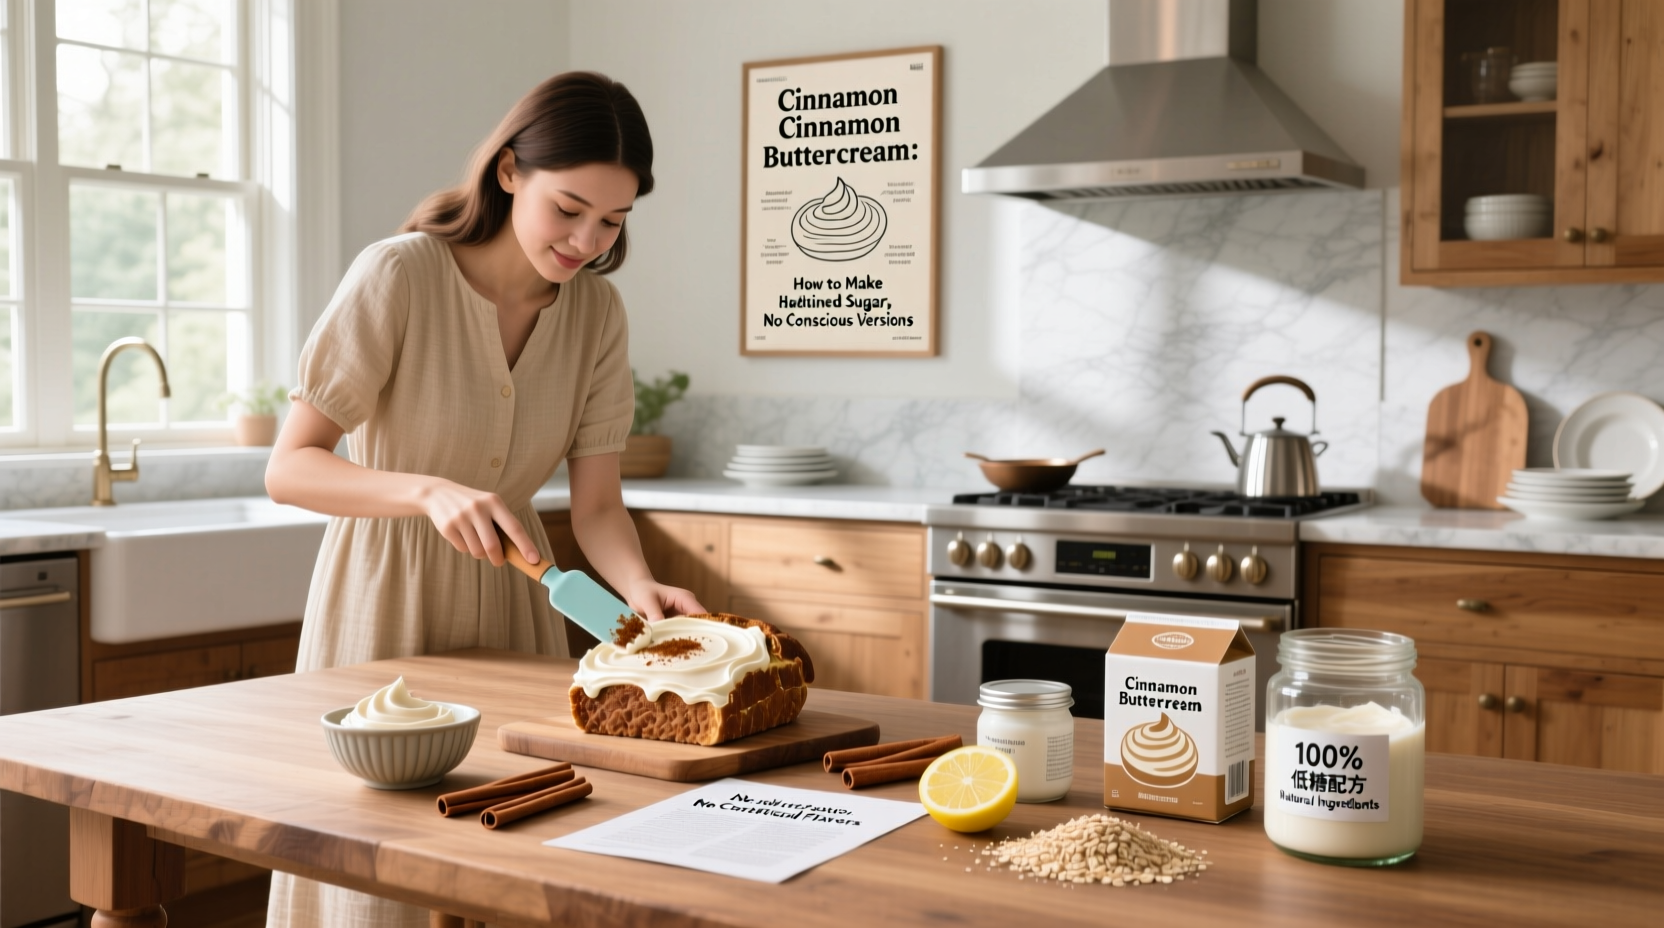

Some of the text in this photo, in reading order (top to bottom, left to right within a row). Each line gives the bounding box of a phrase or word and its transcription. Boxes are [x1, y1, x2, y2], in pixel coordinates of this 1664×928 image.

[778, 87, 898, 112] Cinnamon
[779, 115, 900, 139] Cinnamon
[763, 143, 918, 168] Buttercream:
[793, 274, 883, 290] How to Make
[845, 294, 892, 312] Sugar,
[763, 312, 914, 327] No Conscious Versions
[1125, 676, 1197, 695] Cinnamon
[1295, 742, 1363, 770] 100%
